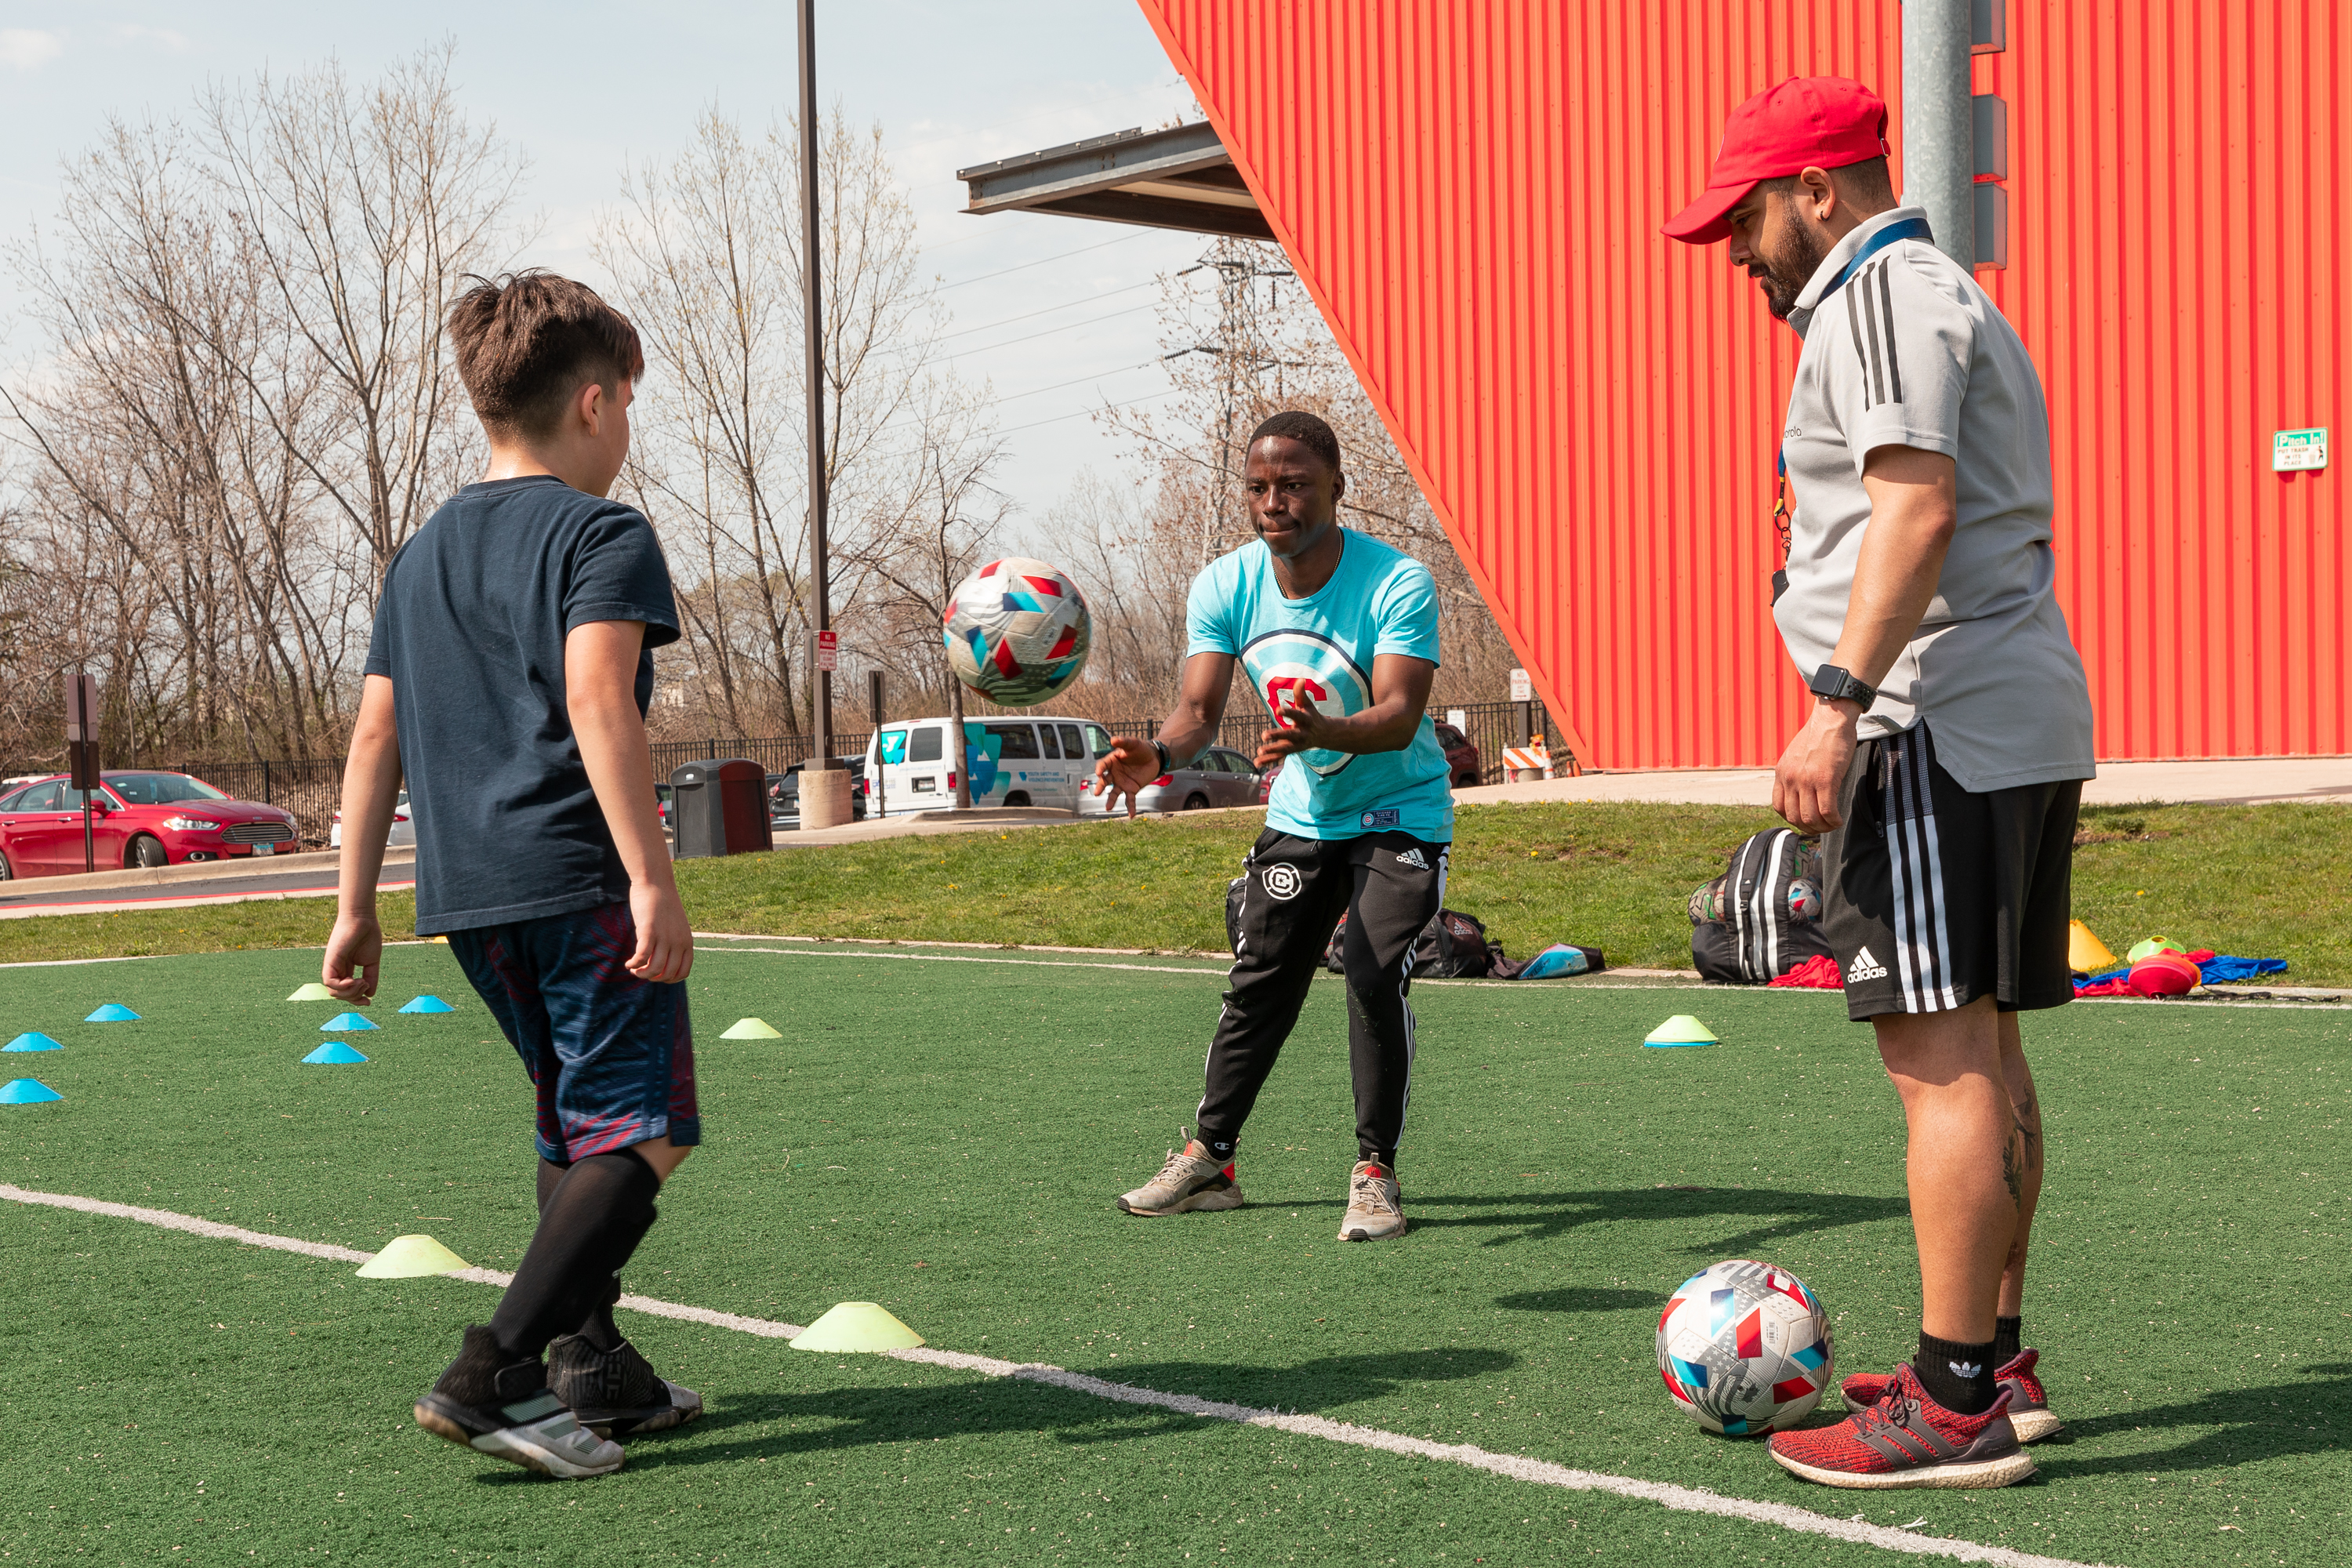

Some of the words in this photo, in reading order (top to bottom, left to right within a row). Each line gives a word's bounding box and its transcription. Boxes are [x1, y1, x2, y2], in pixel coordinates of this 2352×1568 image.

[2279, 435, 2307, 447] Pitch
[2310, 432, 2324, 445] In!
[1396, 855, 1429, 869] adidas
[1847, 967, 1888, 984] adidas
